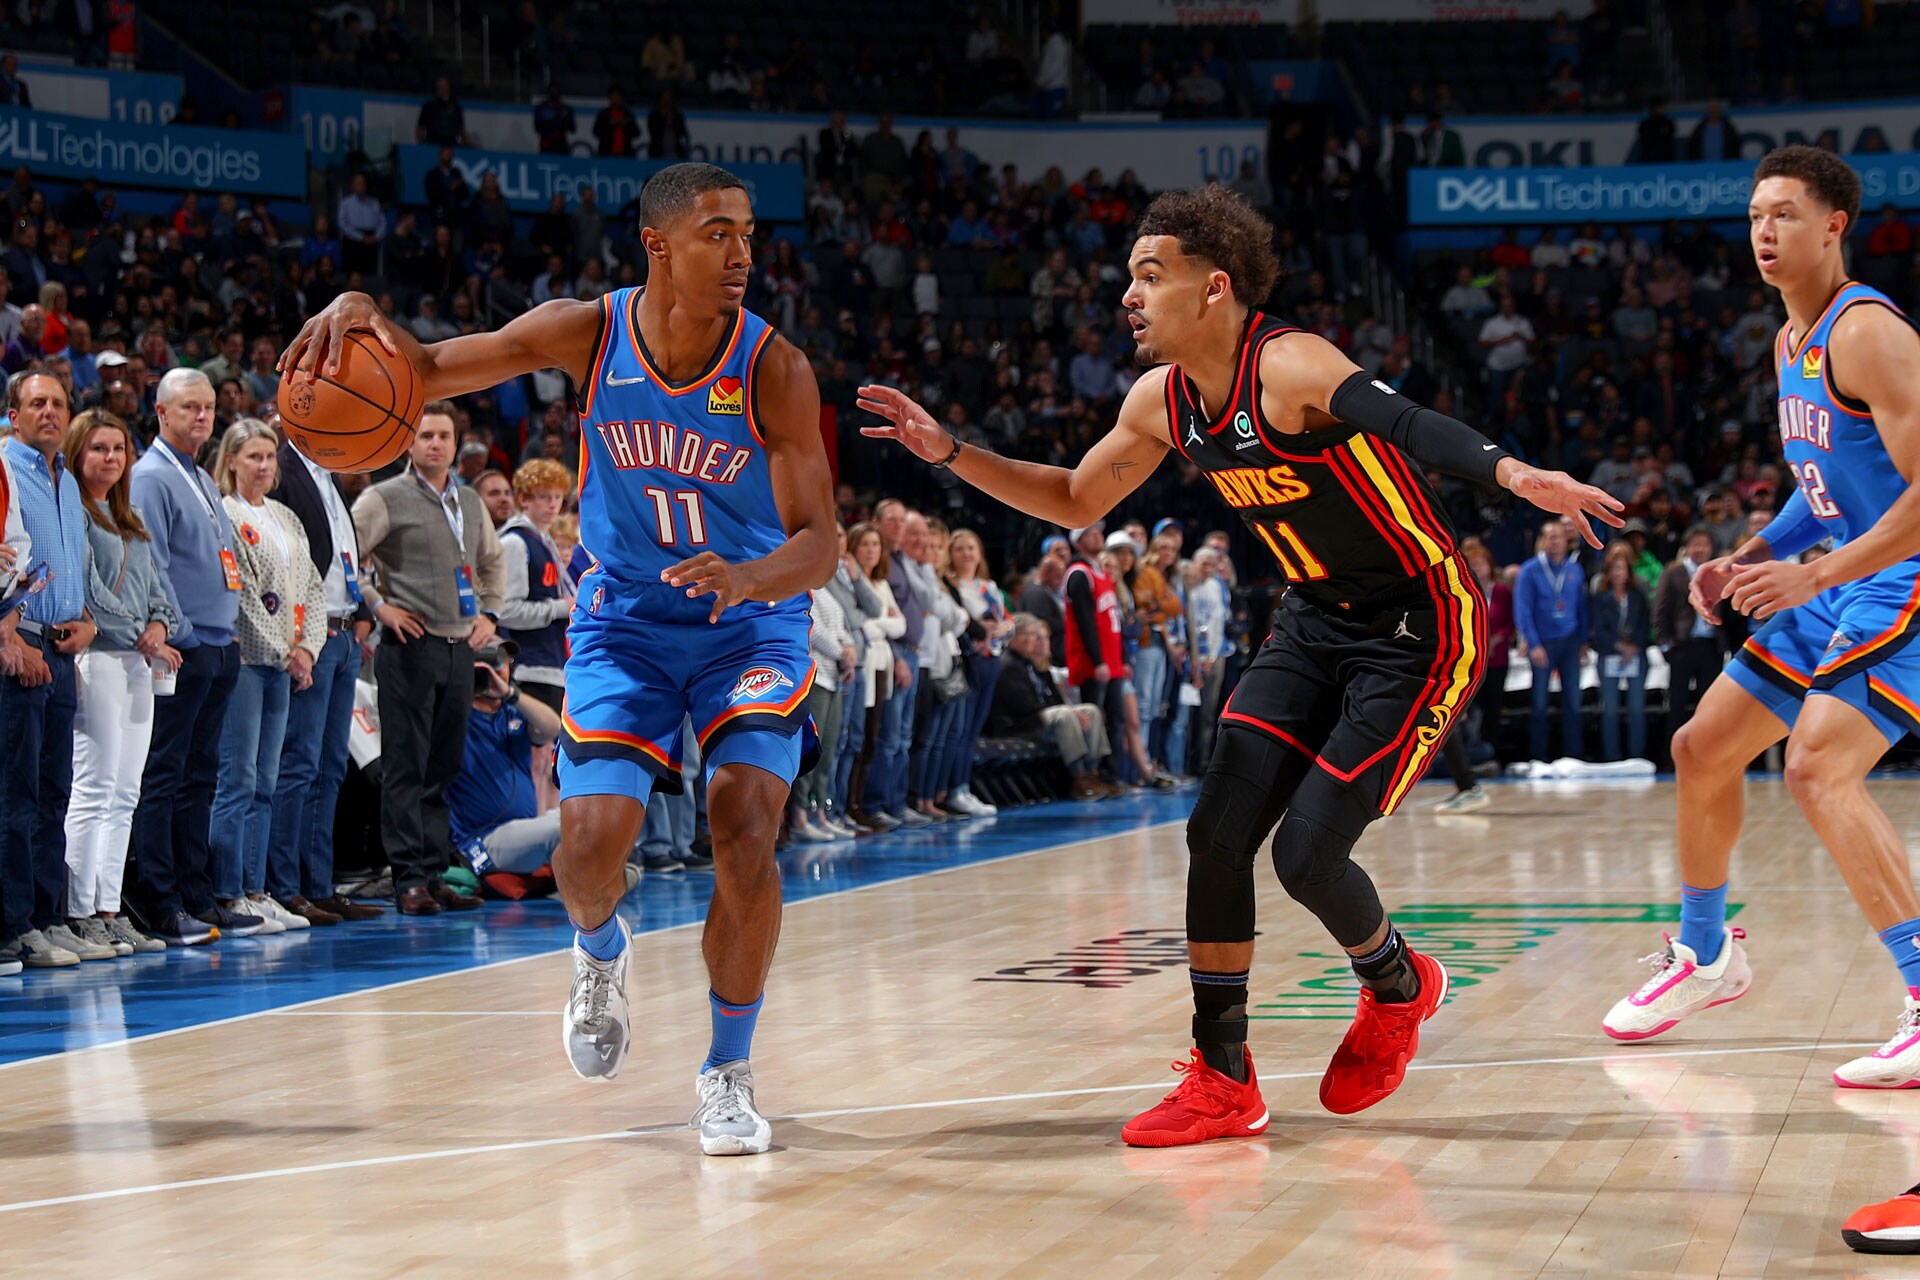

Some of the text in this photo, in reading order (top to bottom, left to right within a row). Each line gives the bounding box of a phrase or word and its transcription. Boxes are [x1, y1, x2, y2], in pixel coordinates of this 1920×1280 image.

[46, 121, 261, 188] Technologies
[1436, 171, 1752, 215] DELL Technologies
[595, 420, 753, 484] THUNDER
[1204, 463, 1312, 509] AWKS
[645, 487, 707, 546] 11
[1253, 521, 1329, 582] 11
[734, 672, 772, 697] OKC
